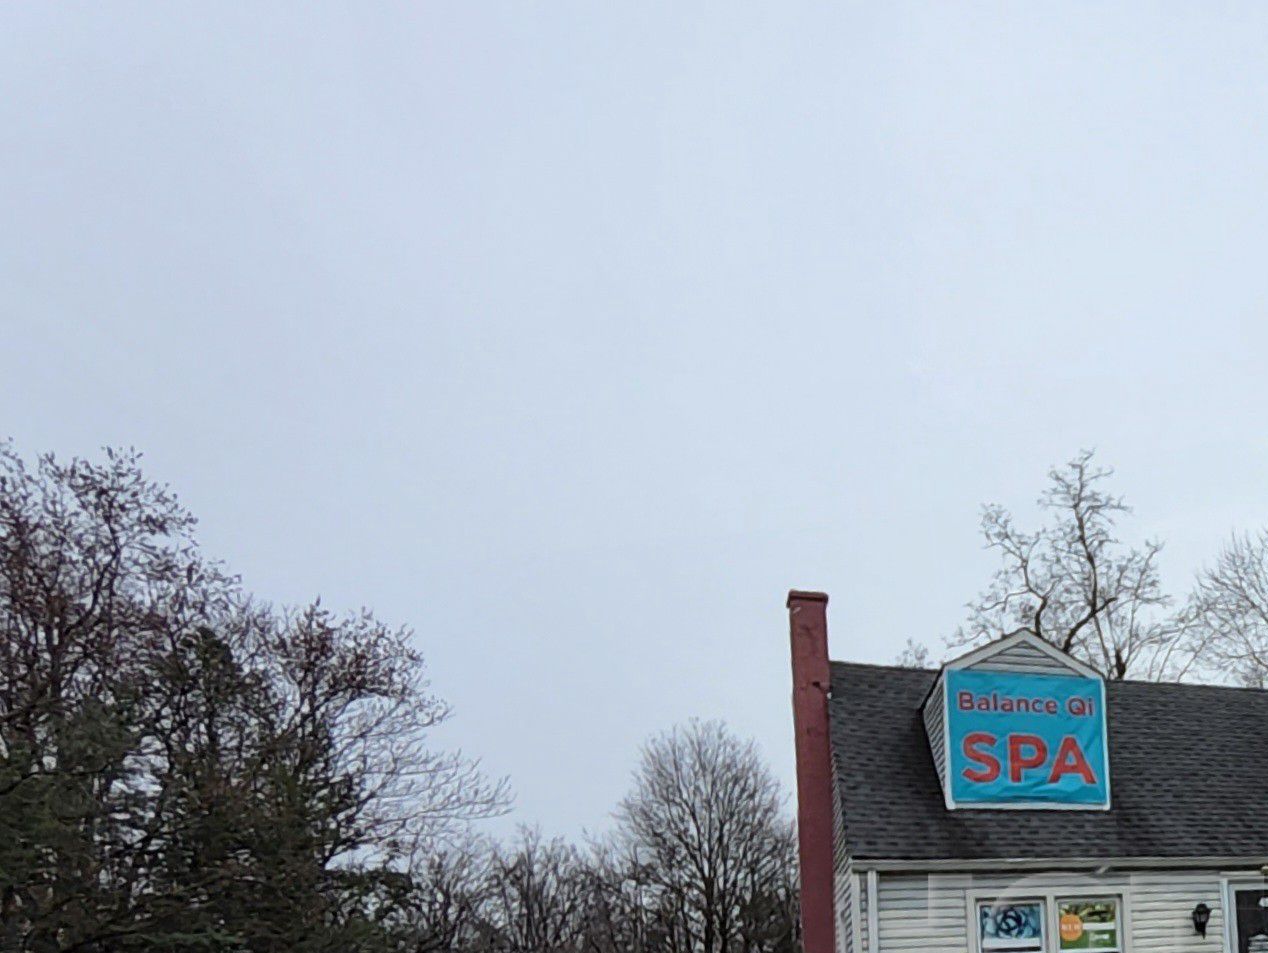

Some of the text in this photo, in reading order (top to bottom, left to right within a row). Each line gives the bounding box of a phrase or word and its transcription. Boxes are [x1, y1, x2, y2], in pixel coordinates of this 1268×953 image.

[958, 691, 1094, 717] Balance Qi
[962, 732, 1097, 784] SPA
